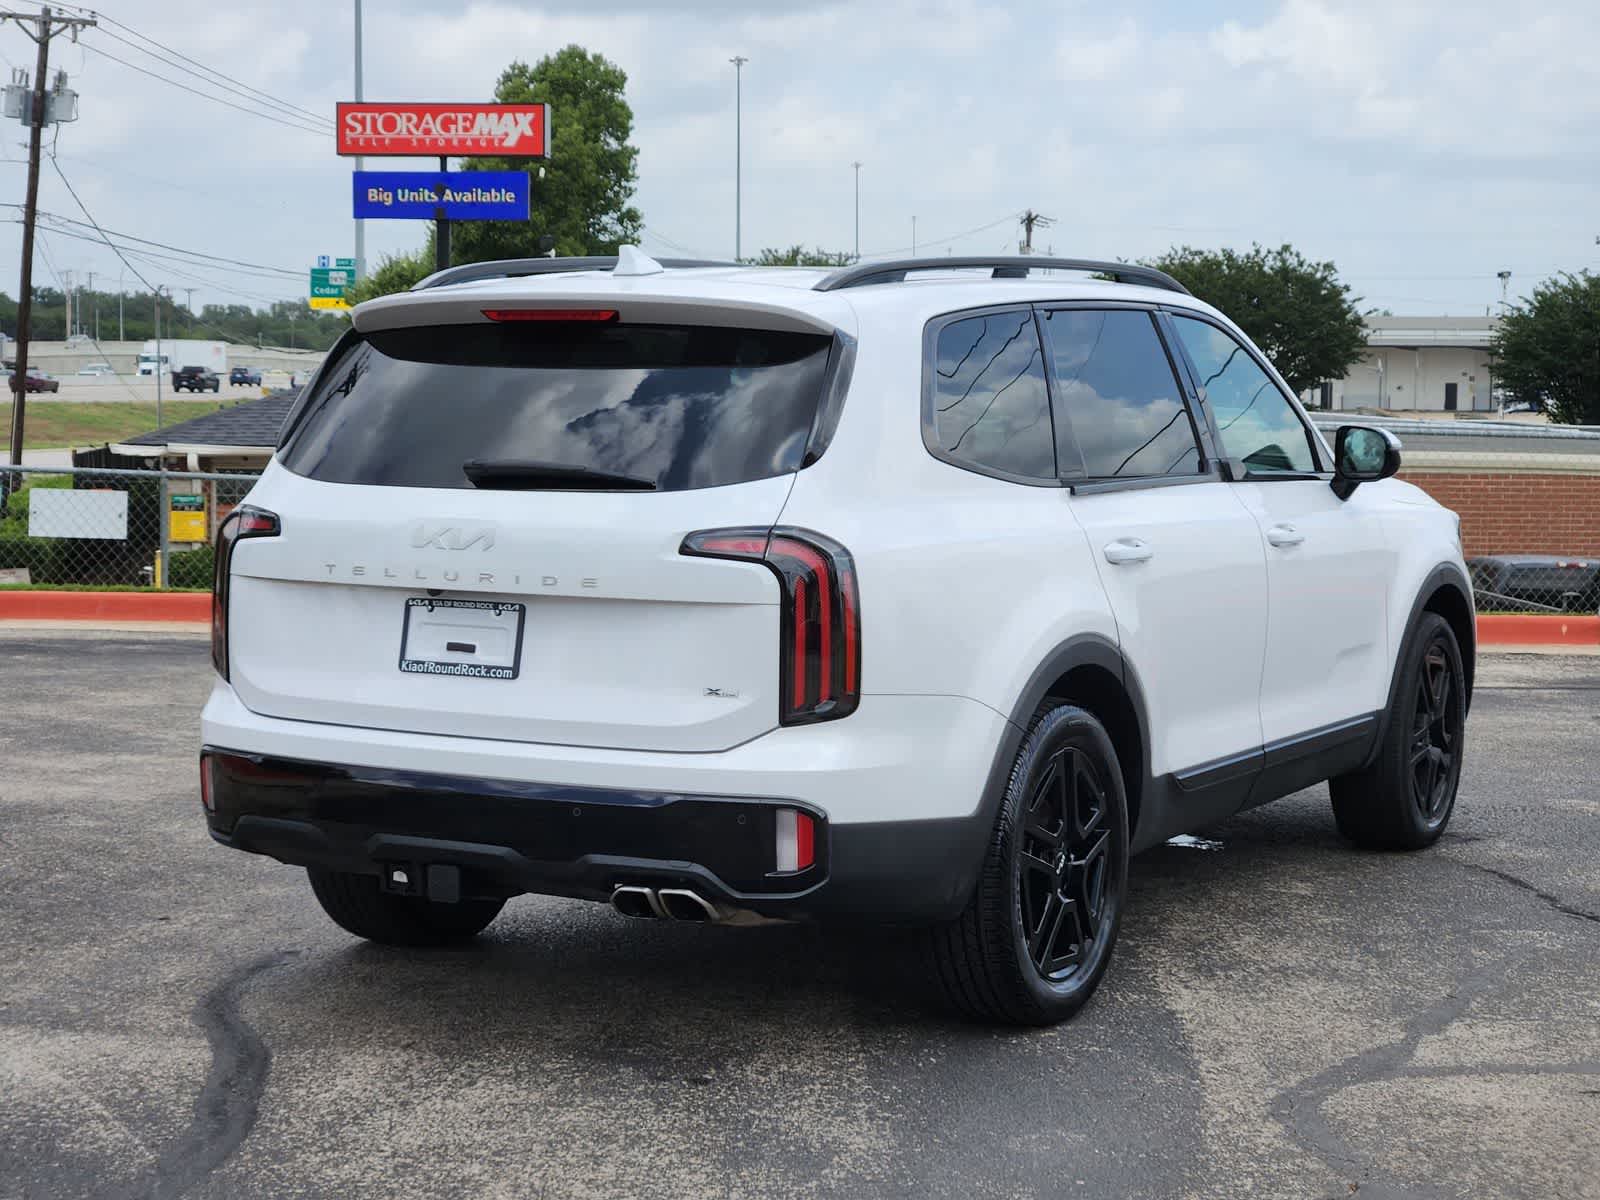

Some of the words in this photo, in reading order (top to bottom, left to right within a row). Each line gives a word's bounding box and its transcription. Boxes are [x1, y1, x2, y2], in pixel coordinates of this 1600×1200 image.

[345, 137, 392, 146] SELF
[412, 137, 500, 147] STORAGE
[367, 188, 393, 205] Big
[398, 188, 438, 203] Units
[442, 188, 516, 203] Available
[325, 563, 599, 588] TELLURIDE
[401, 660, 513, 678] KiaofRoundRock.com
